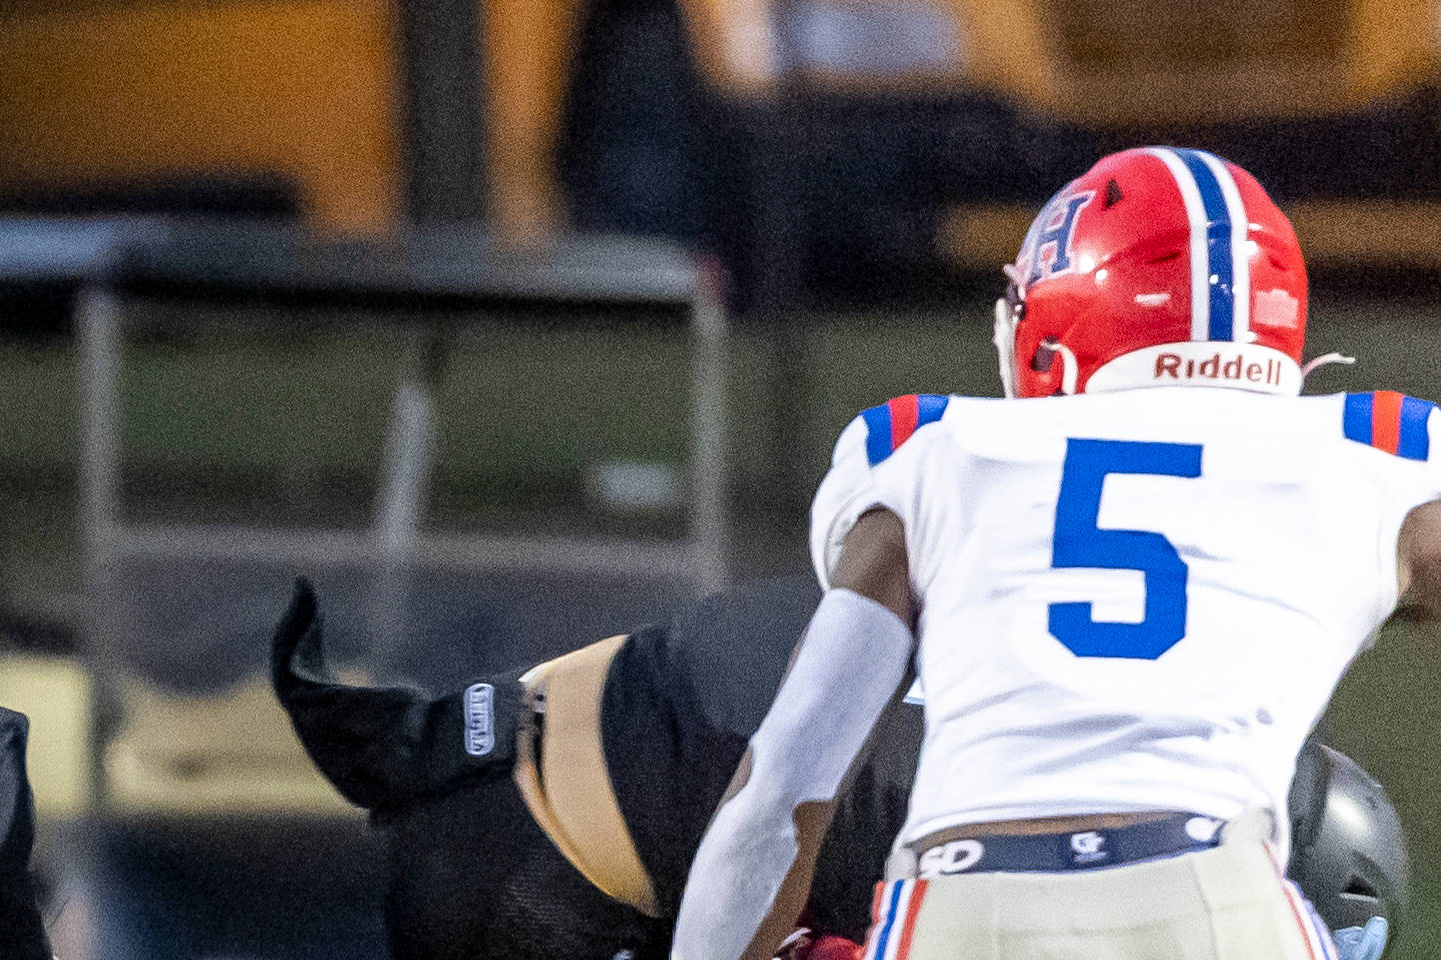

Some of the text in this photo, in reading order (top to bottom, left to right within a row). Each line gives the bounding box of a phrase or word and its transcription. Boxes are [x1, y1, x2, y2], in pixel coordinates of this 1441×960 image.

[1016, 189, 1097, 288] H
[1154, 352, 1282, 387] Riddell
[1047, 437, 1204, 661] 5
